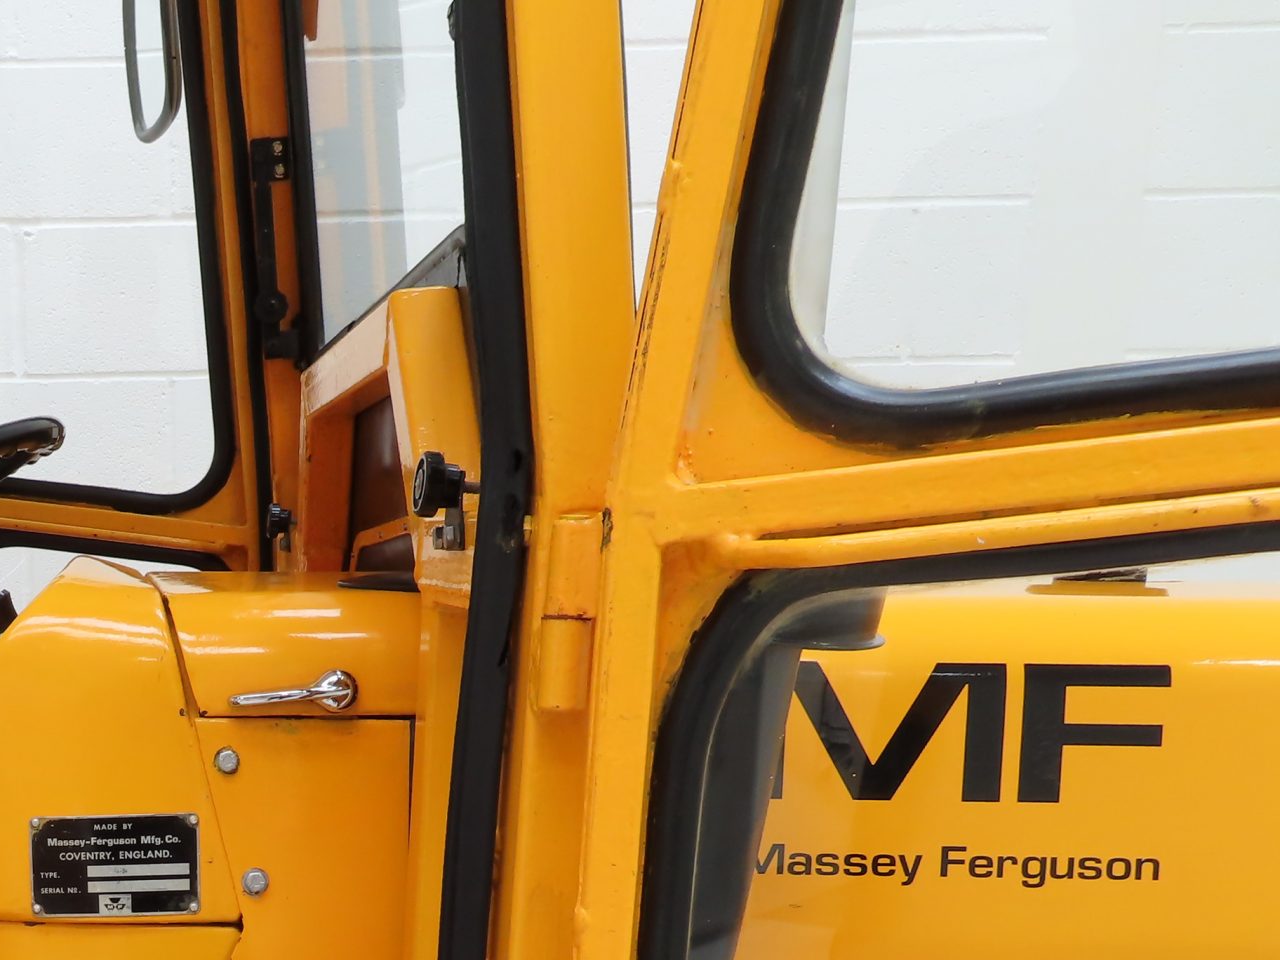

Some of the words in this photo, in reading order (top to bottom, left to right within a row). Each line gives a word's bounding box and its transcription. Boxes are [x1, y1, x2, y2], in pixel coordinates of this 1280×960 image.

[770, 661, 1172, 803] MF
[93, 823, 118, 831] MADE
[47, 836, 137, 848] Massey-Ferguson
[140, 835, 164, 846] Mfg.
[165, 834, 182, 844] Co.
[59, 851, 115, 861] COVENTRY,
[119, 849, 173, 860] ENGLAND.
[939, 845, 1161, 889] Ferguson
[40, 871, 61, 879] TYPE.
